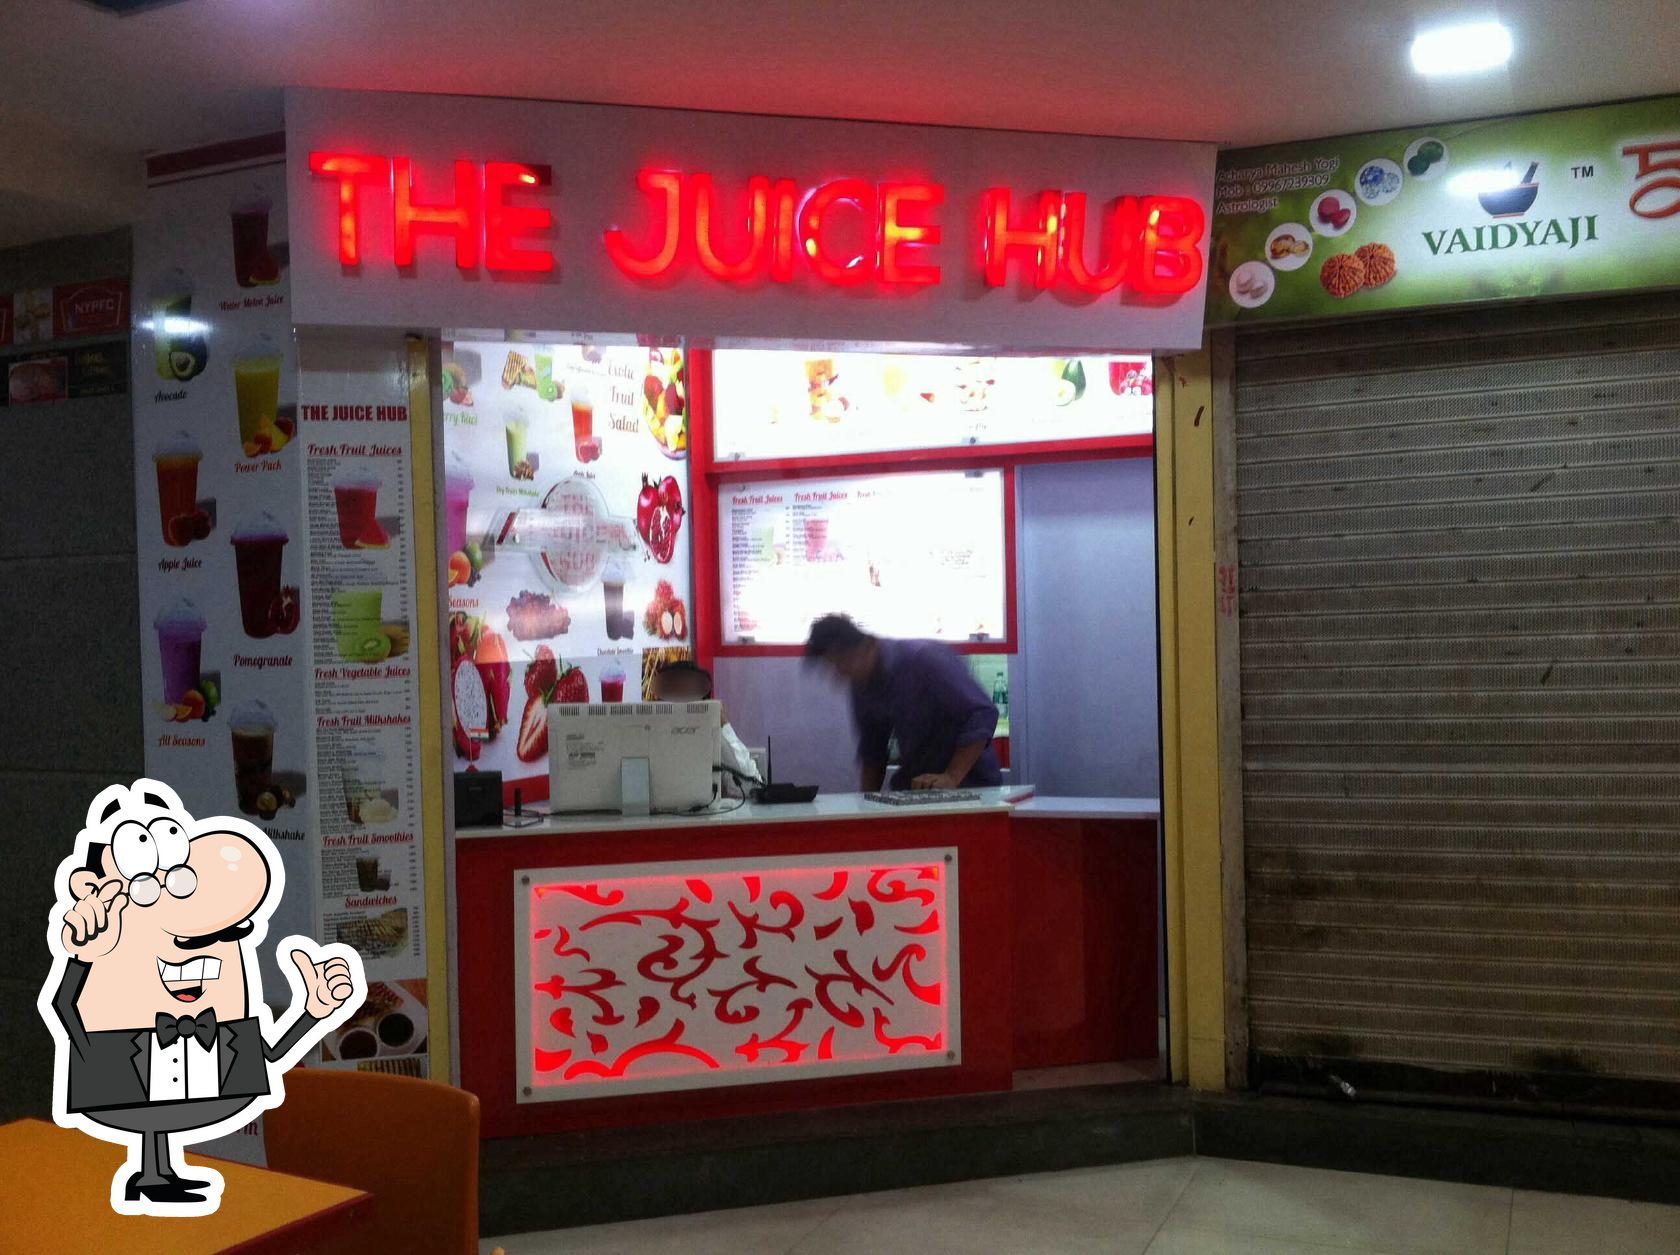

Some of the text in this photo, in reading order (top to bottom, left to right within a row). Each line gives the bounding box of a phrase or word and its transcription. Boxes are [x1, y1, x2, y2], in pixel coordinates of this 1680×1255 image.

[1314, 156, 1340, 171] Yogi
[1571, 165, 1594, 179] TM
[1216, 197, 1279, 214] Astrologist
[308, 151, 1204, 294] THE JUICE HUB
[1421, 214, 1599, 256] VAIDYAJI
[301, 405, 408, 421] THE JUICE HUB
[607, 412, 640, 434] Salad
[307, 443, 403, 457] Fresh Fruit Juices
[158, 557, 202, 572] Apple Juice
[233, 654, 293, 670] Pomegranate
[315, 665, 411, 680] Fresh Vegetable Juices
[317, 713, 412, 727] Fresh Fruit Milkshakes
[173, 735, 206, 747] Seasons
[322, 831, 415, 848] Fresh Fruit Smoothies
[344, 895, 398, 909] Sandwiches
